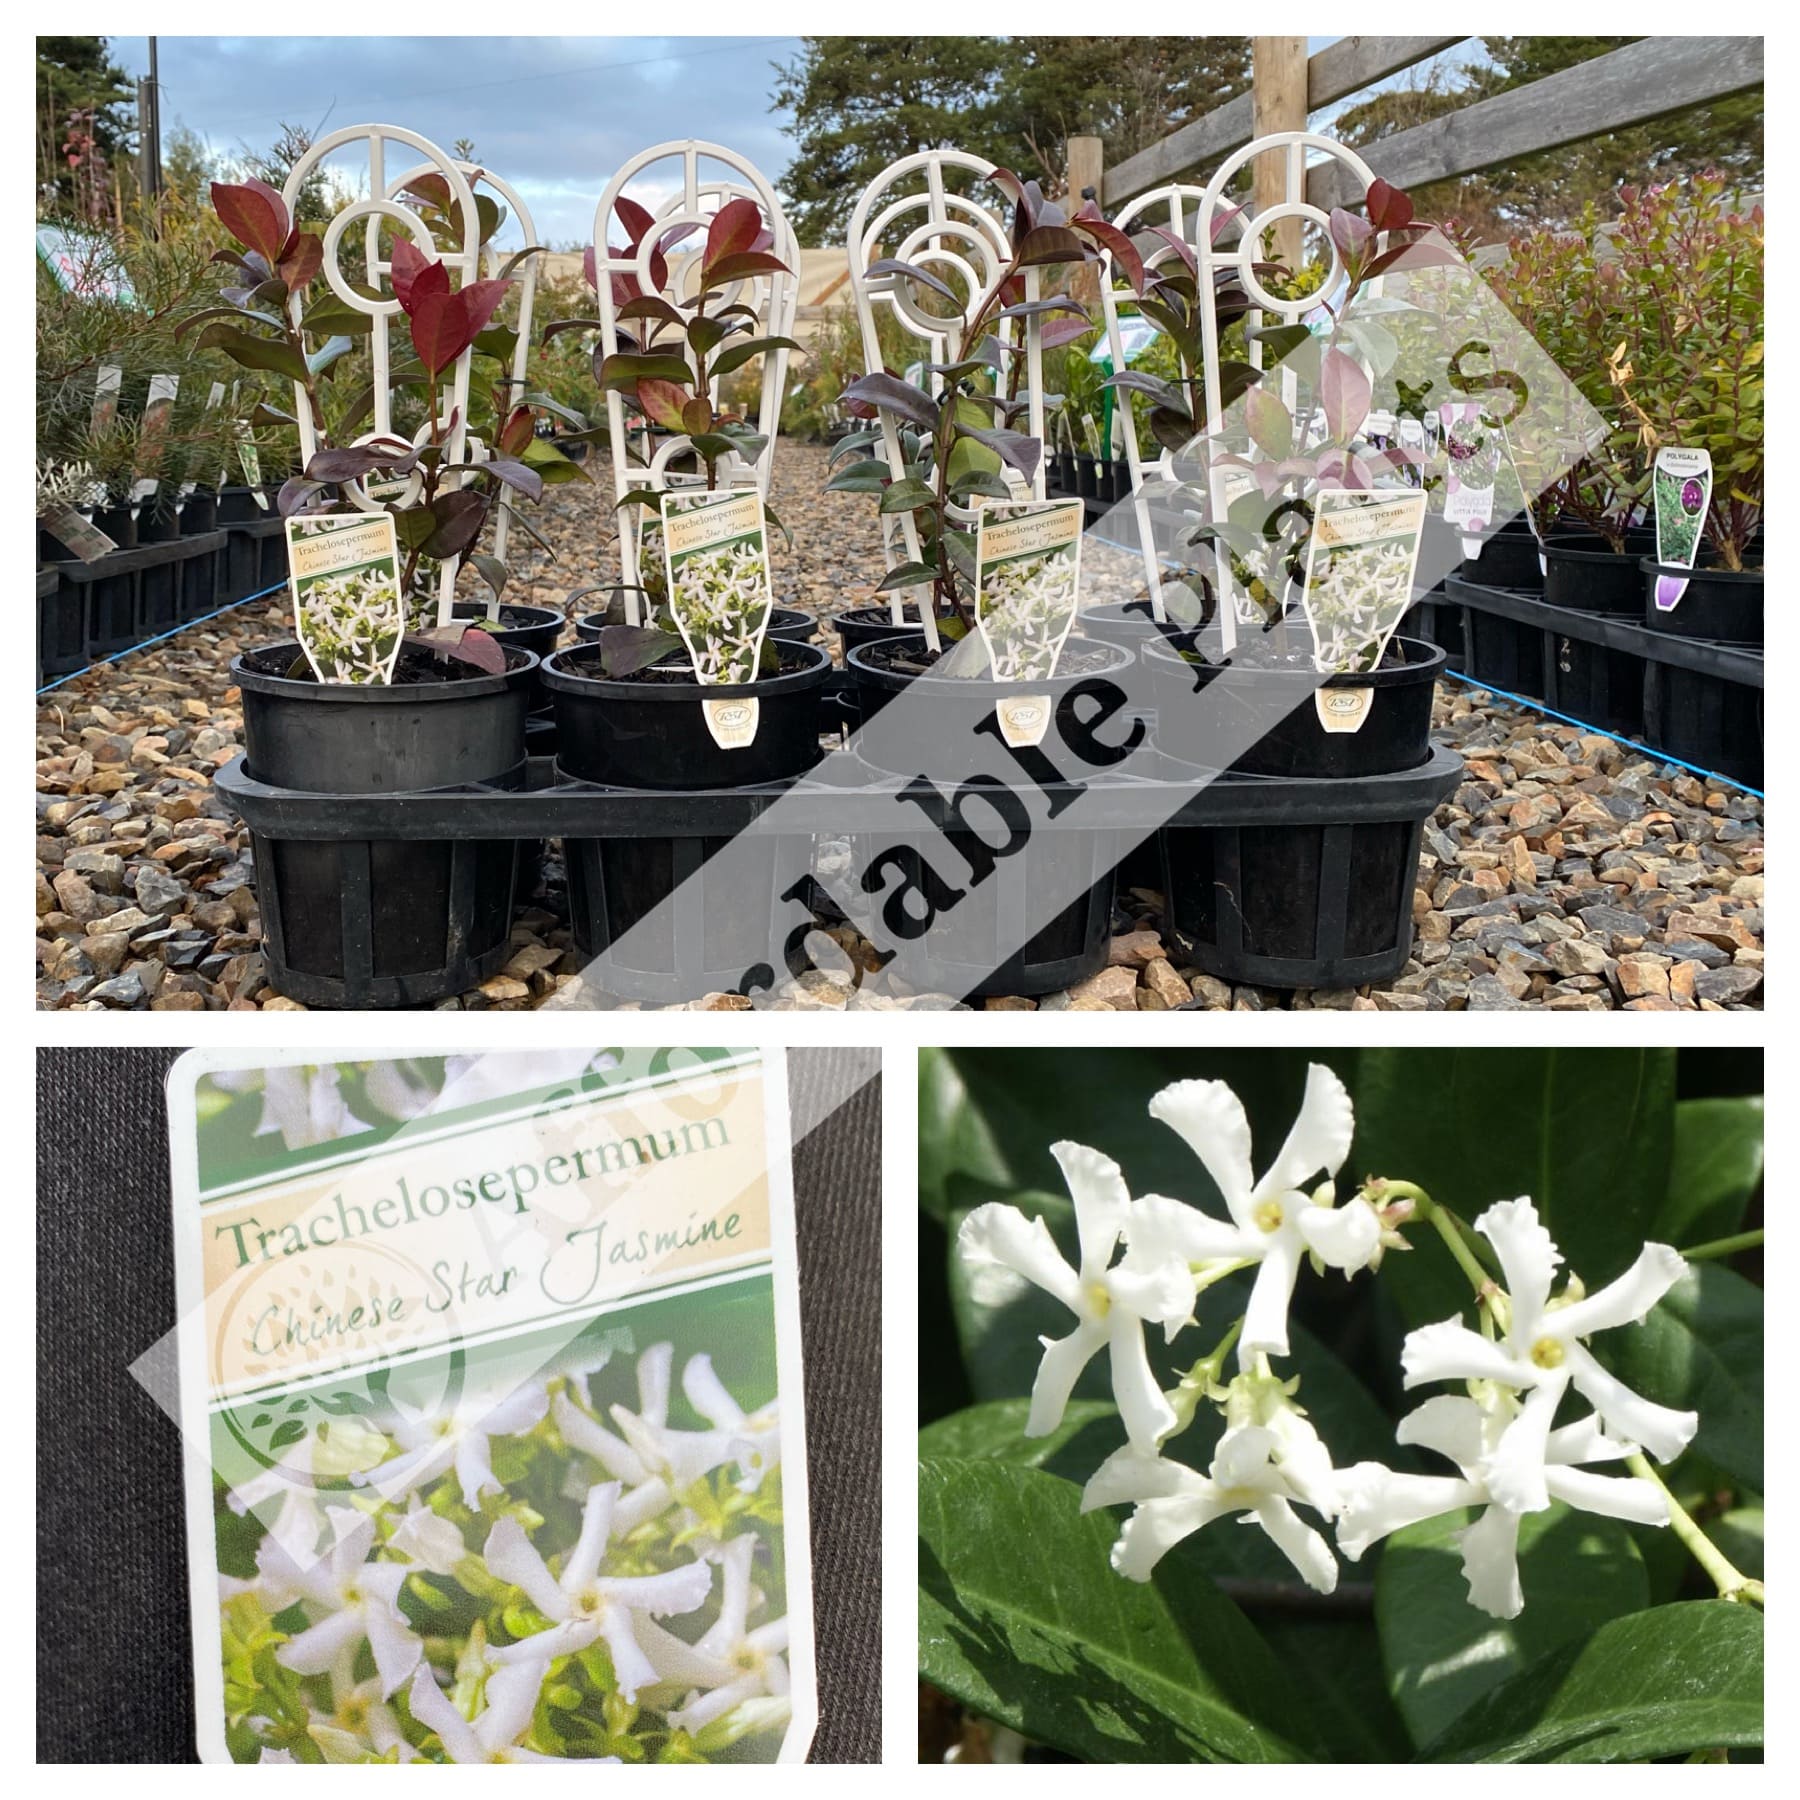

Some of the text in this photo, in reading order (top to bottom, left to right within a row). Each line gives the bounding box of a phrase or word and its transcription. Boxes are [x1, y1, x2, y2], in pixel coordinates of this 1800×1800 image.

[1666, 452, 1699, 461] POLYGALA
[985, 513, 1074, 542] Trachelosepermum
[298, 528, 386, 557] Trachelosepermum
[214, 1116, 730, 1269] Trachelosepermum
[251, 1211, 743, 1357] Chinese Star Jasmine
